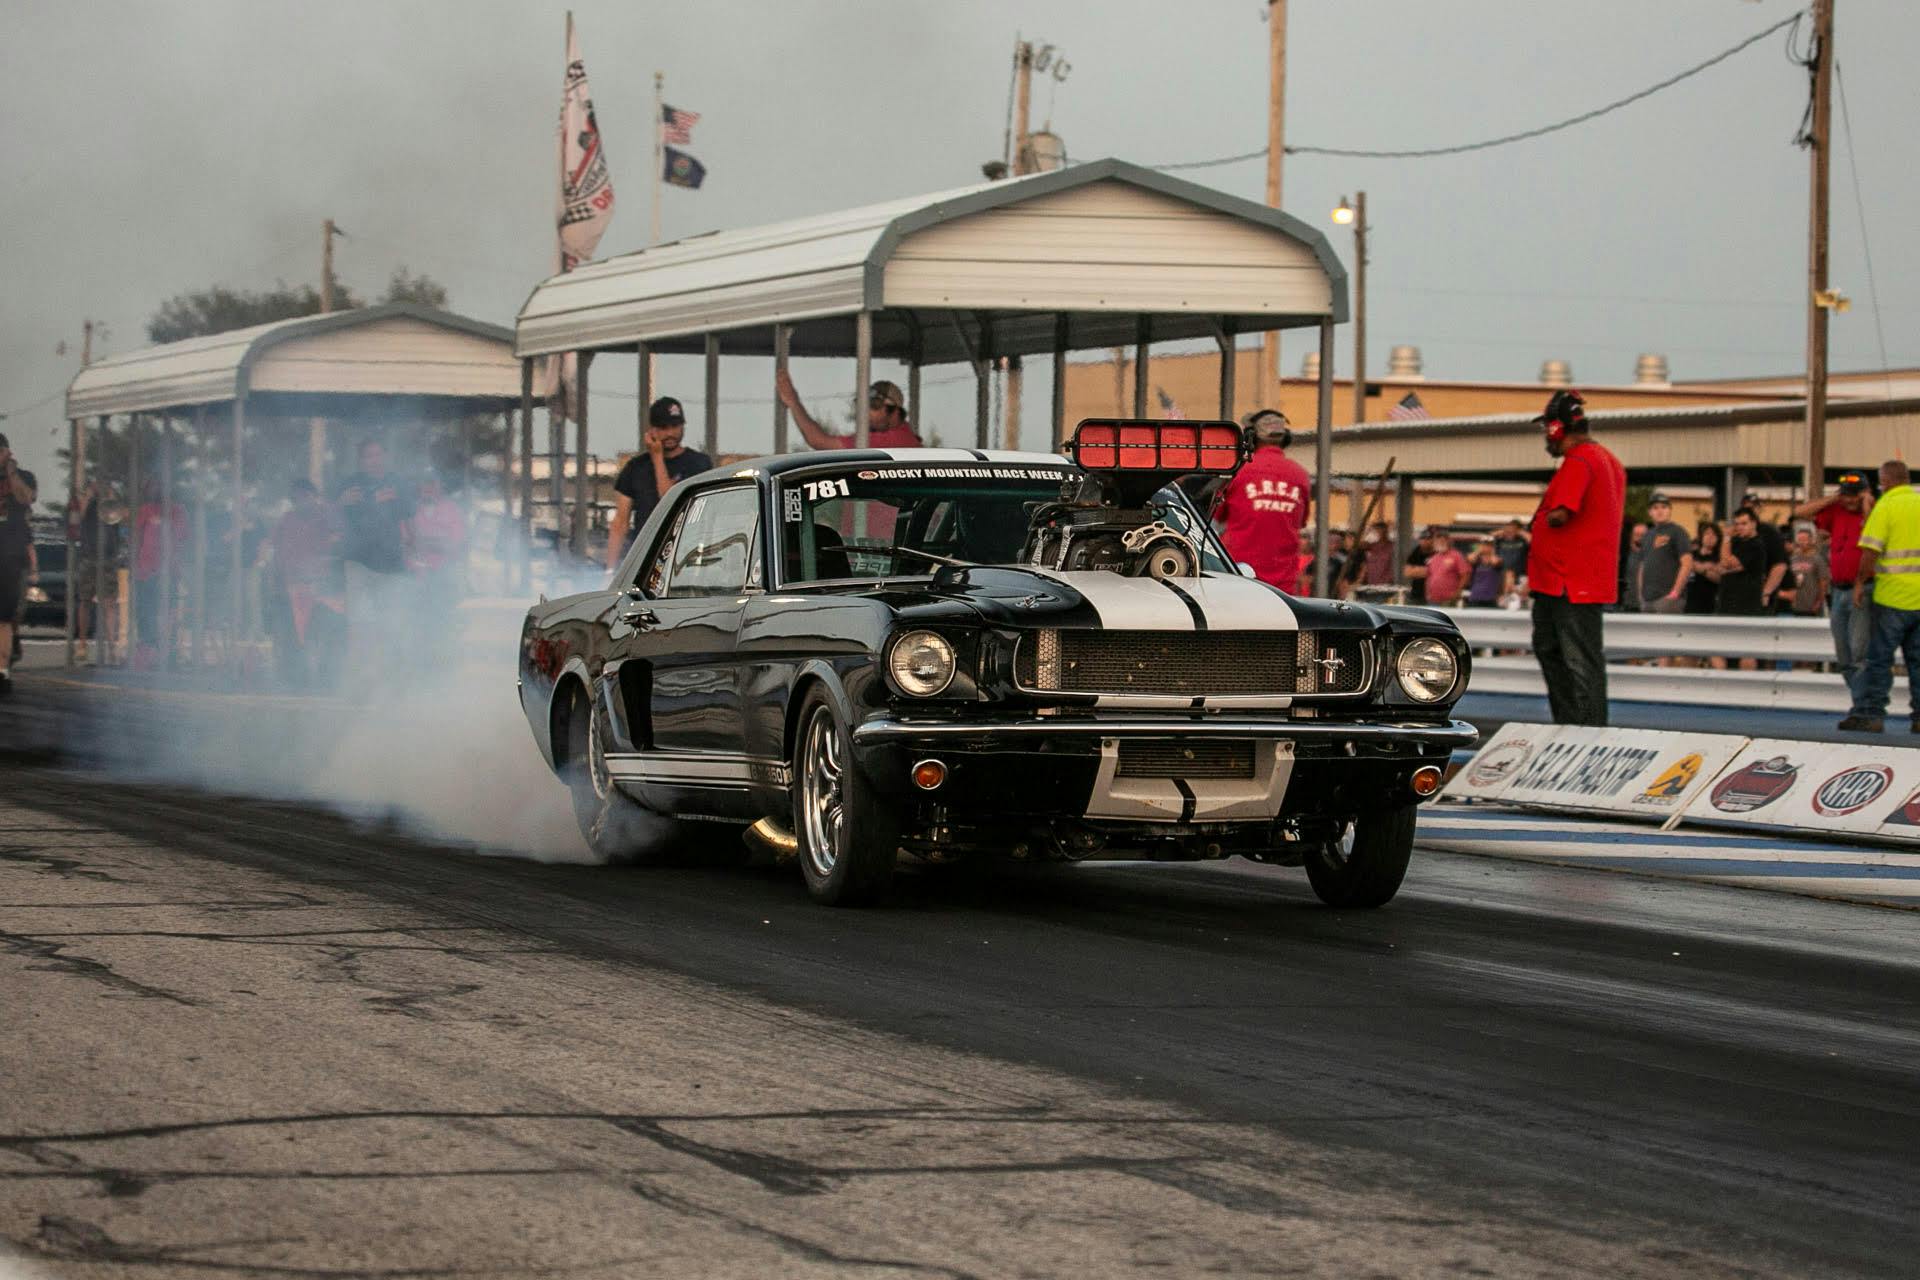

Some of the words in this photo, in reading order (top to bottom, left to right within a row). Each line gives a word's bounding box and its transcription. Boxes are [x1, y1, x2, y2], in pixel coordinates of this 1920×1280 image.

[878, 469, 922, 480] ROCKY
[924, 468, 992, 479] MOUNTAIN
[993, 468, 1028, 479] RACE
[1027, 470, 1063, 481] WEEK
[803, 478, 850, 501] 781
[789, 487, 803, 522] 1320
[1253, 498, 1296, 513] STAFF
[1821, 772, 1884, 808] NHRA
